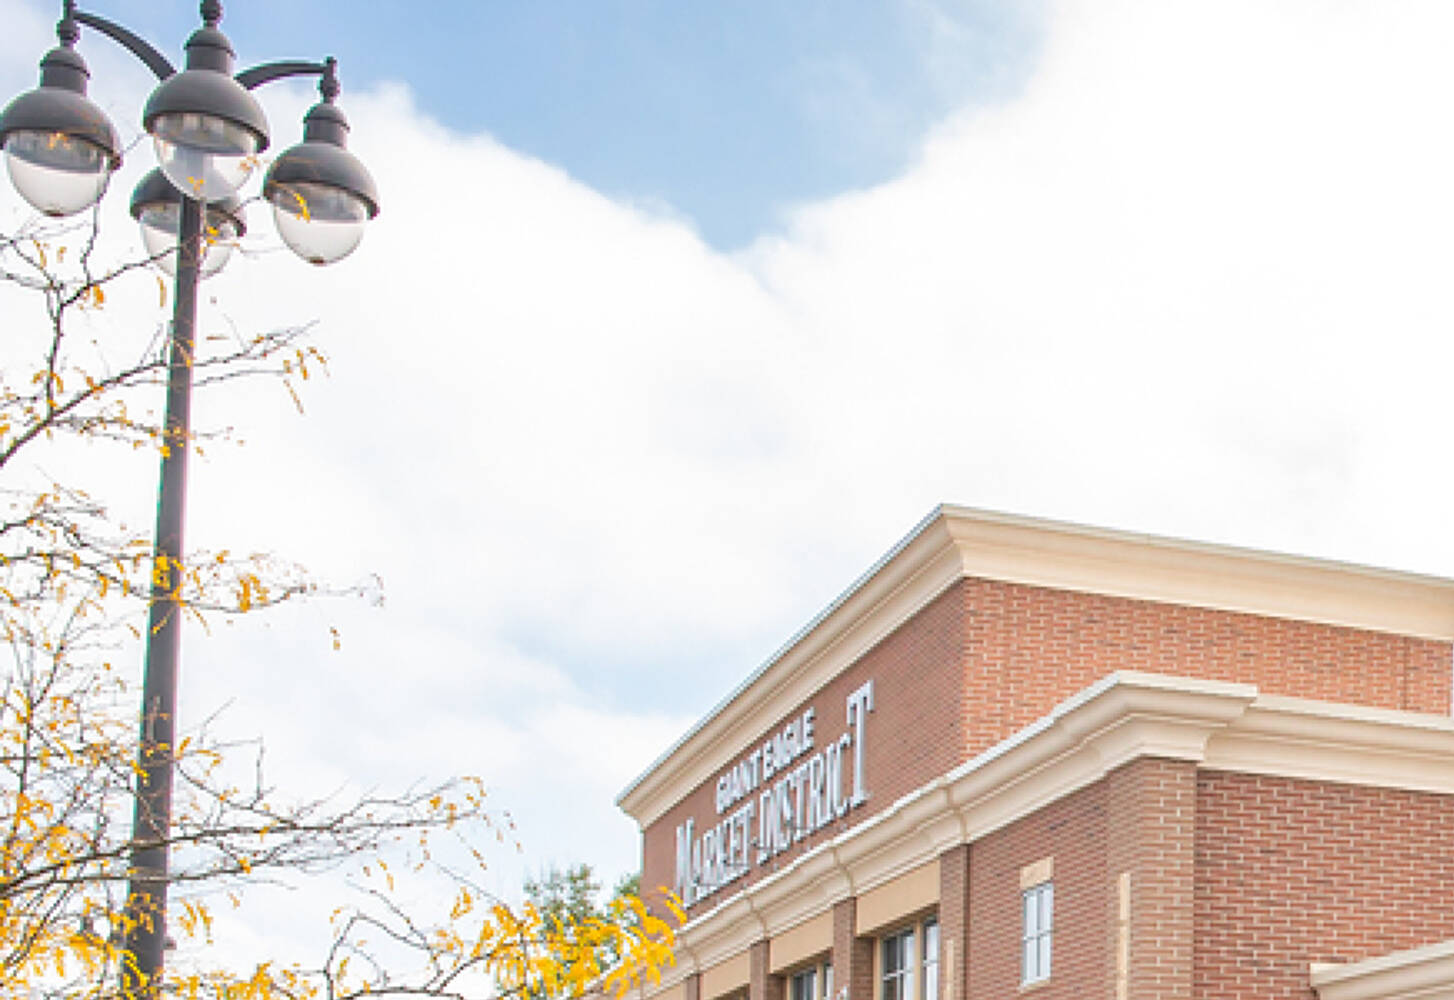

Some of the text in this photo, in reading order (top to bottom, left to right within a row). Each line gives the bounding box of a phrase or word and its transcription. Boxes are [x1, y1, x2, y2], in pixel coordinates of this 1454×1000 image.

[676, 679, 875, 910] MARKET DISTRICT
[716, 706, 815, 815] GIANT EAGLE
